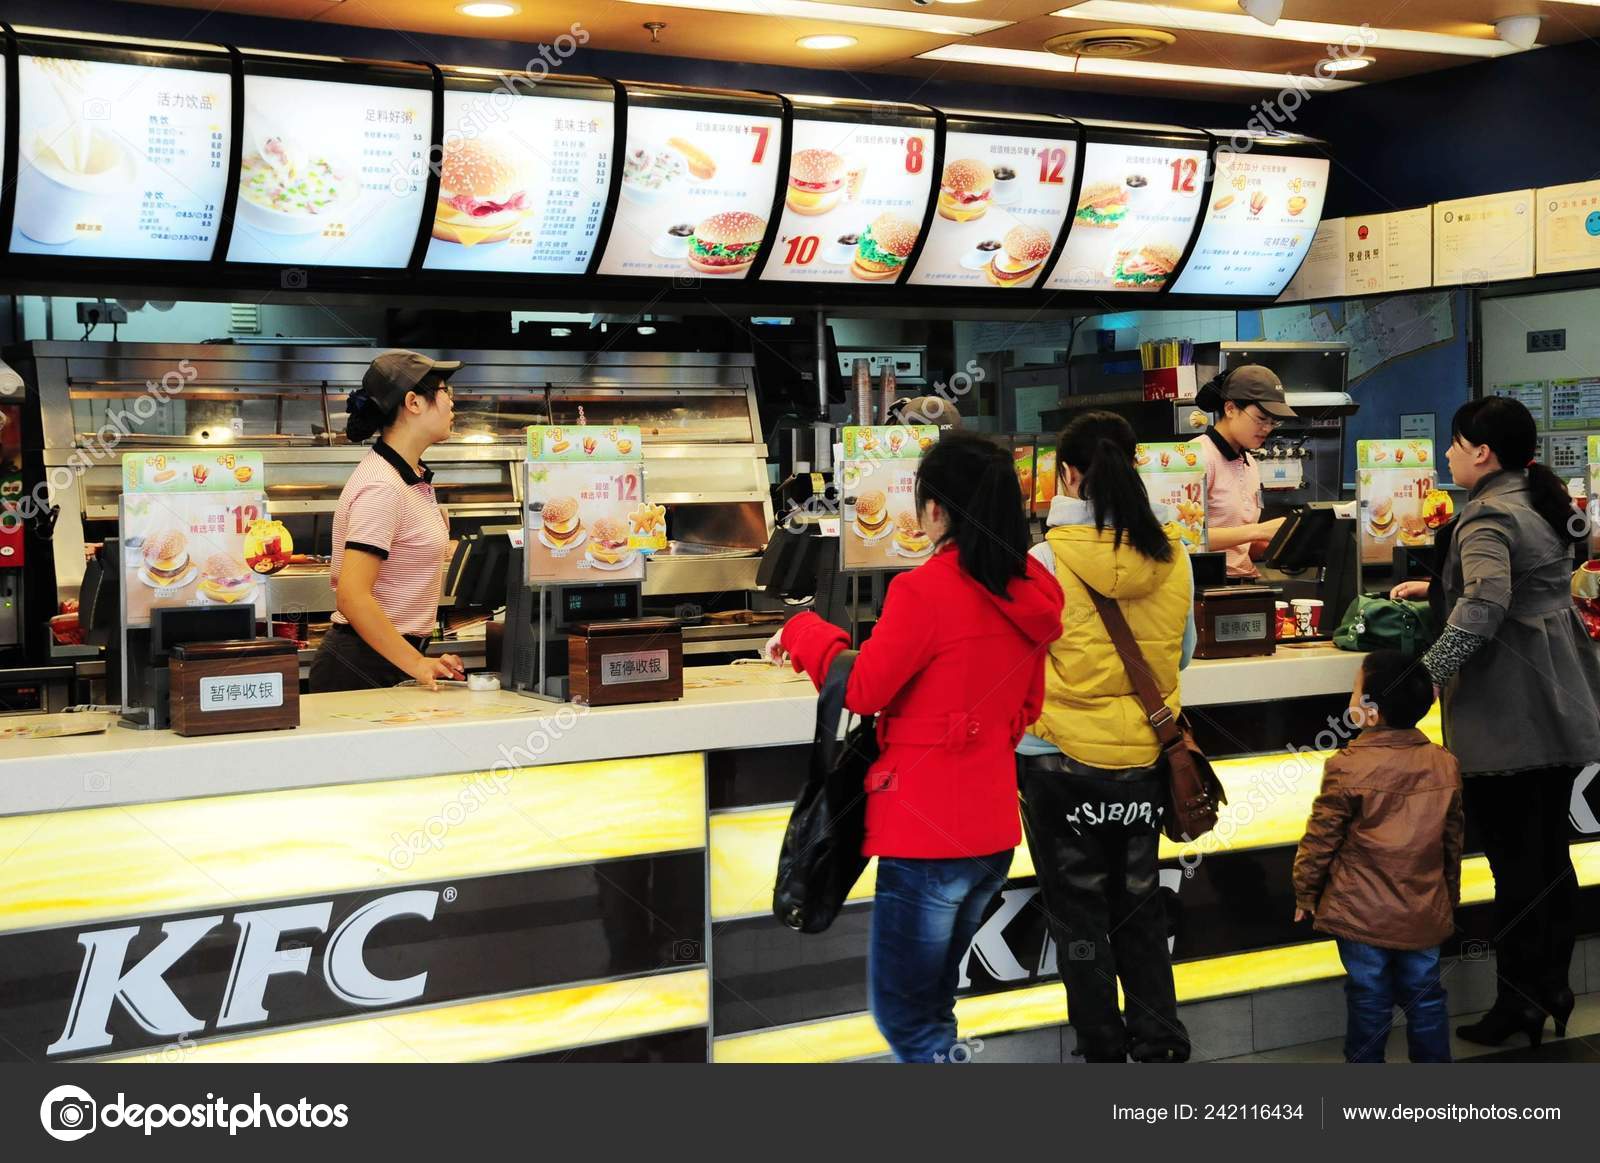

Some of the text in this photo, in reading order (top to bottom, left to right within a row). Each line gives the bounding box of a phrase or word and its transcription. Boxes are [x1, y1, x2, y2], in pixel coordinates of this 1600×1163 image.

[157, 92, 212, 110] 活力饮品
[365, 109, 413, 125] 足料好粥
[555, 118, 599, 133] 美味主食
[1348, 248, 1379, 262] 营业执照
[190, 523, 226, 535] 精选早餐
[1220, 619, 1262, 635] 暂停收银
[609, 658, 662, 677] 暂停收银
[210, 682, 273, 702] 暂停收银
[46, 890, 440, 1056] KFC
